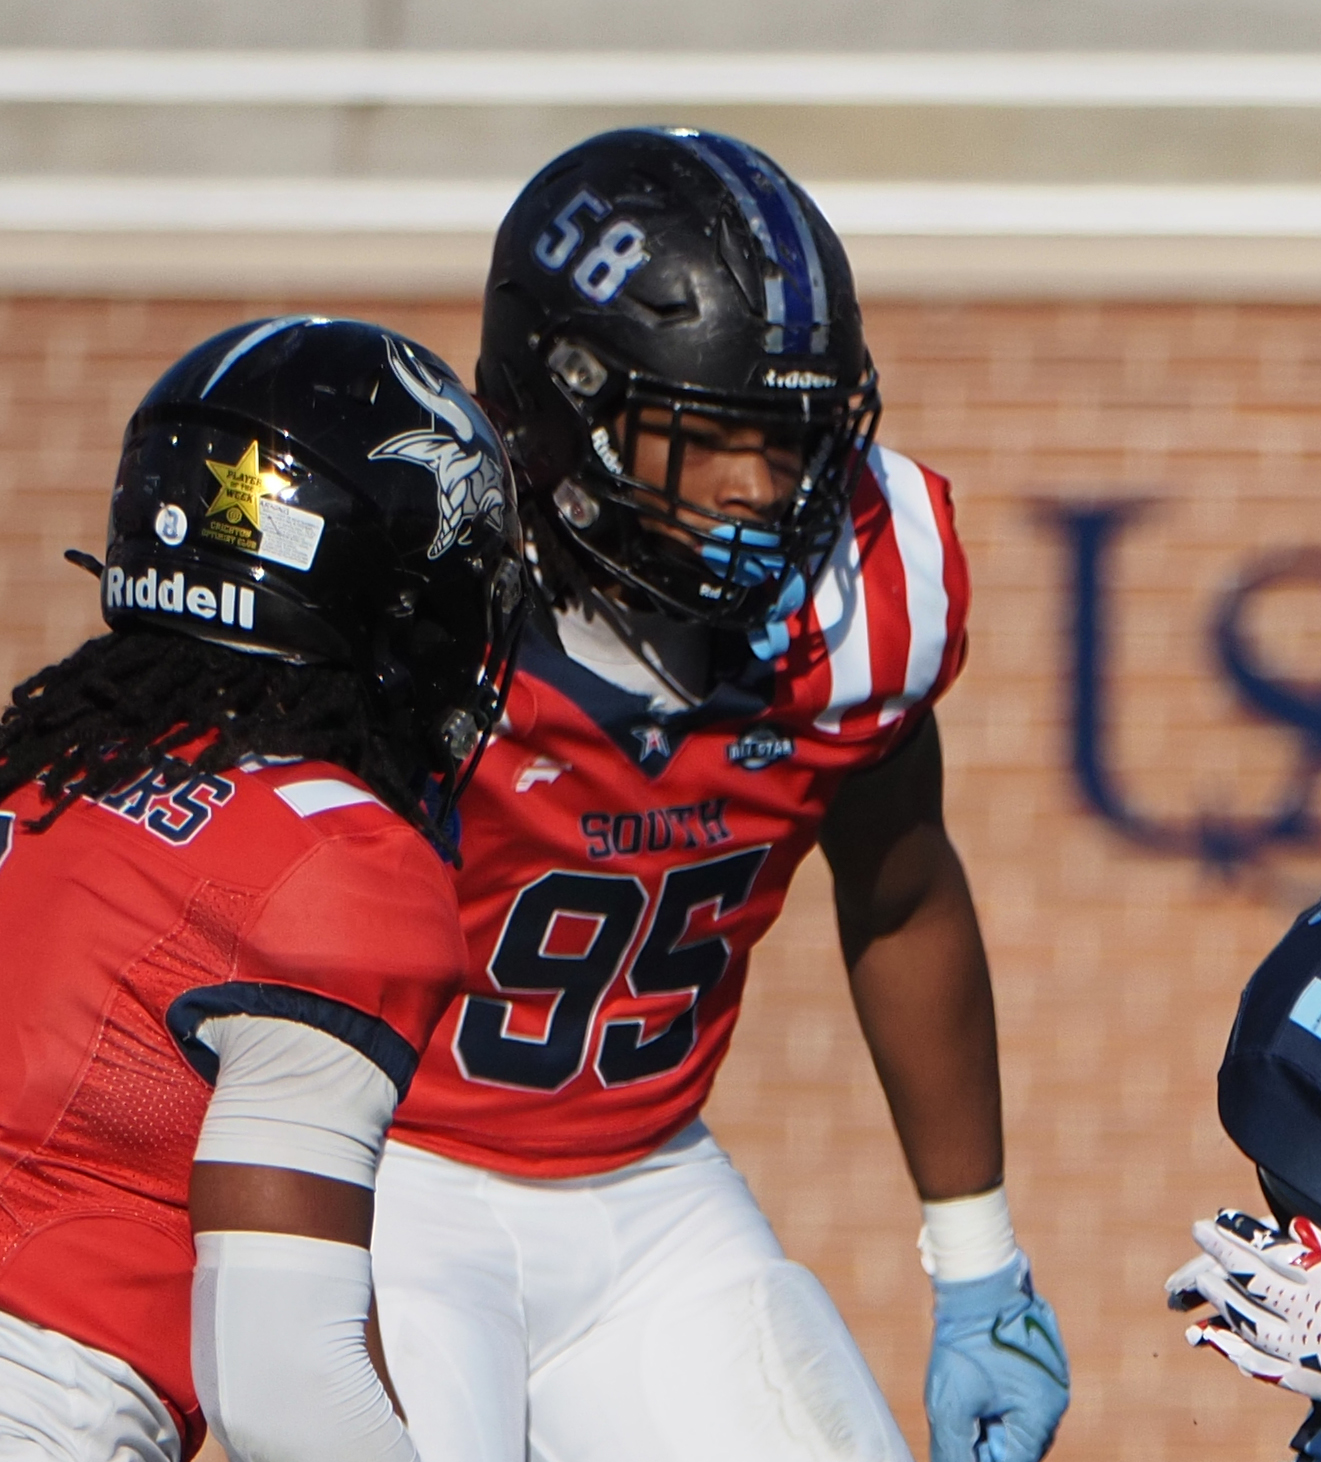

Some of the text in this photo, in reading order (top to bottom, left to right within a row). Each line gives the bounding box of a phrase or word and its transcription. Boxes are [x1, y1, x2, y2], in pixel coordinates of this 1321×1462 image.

[534, 186, 652, 305] 58
[225, 490, 253, 504] WEEK
[226, 469, 262, 488] PLAYER
[106, 565, 255, 631] Riddell
[579, 799, 734, 862] SOUTH
[451, 841, 775, 1097] 95
